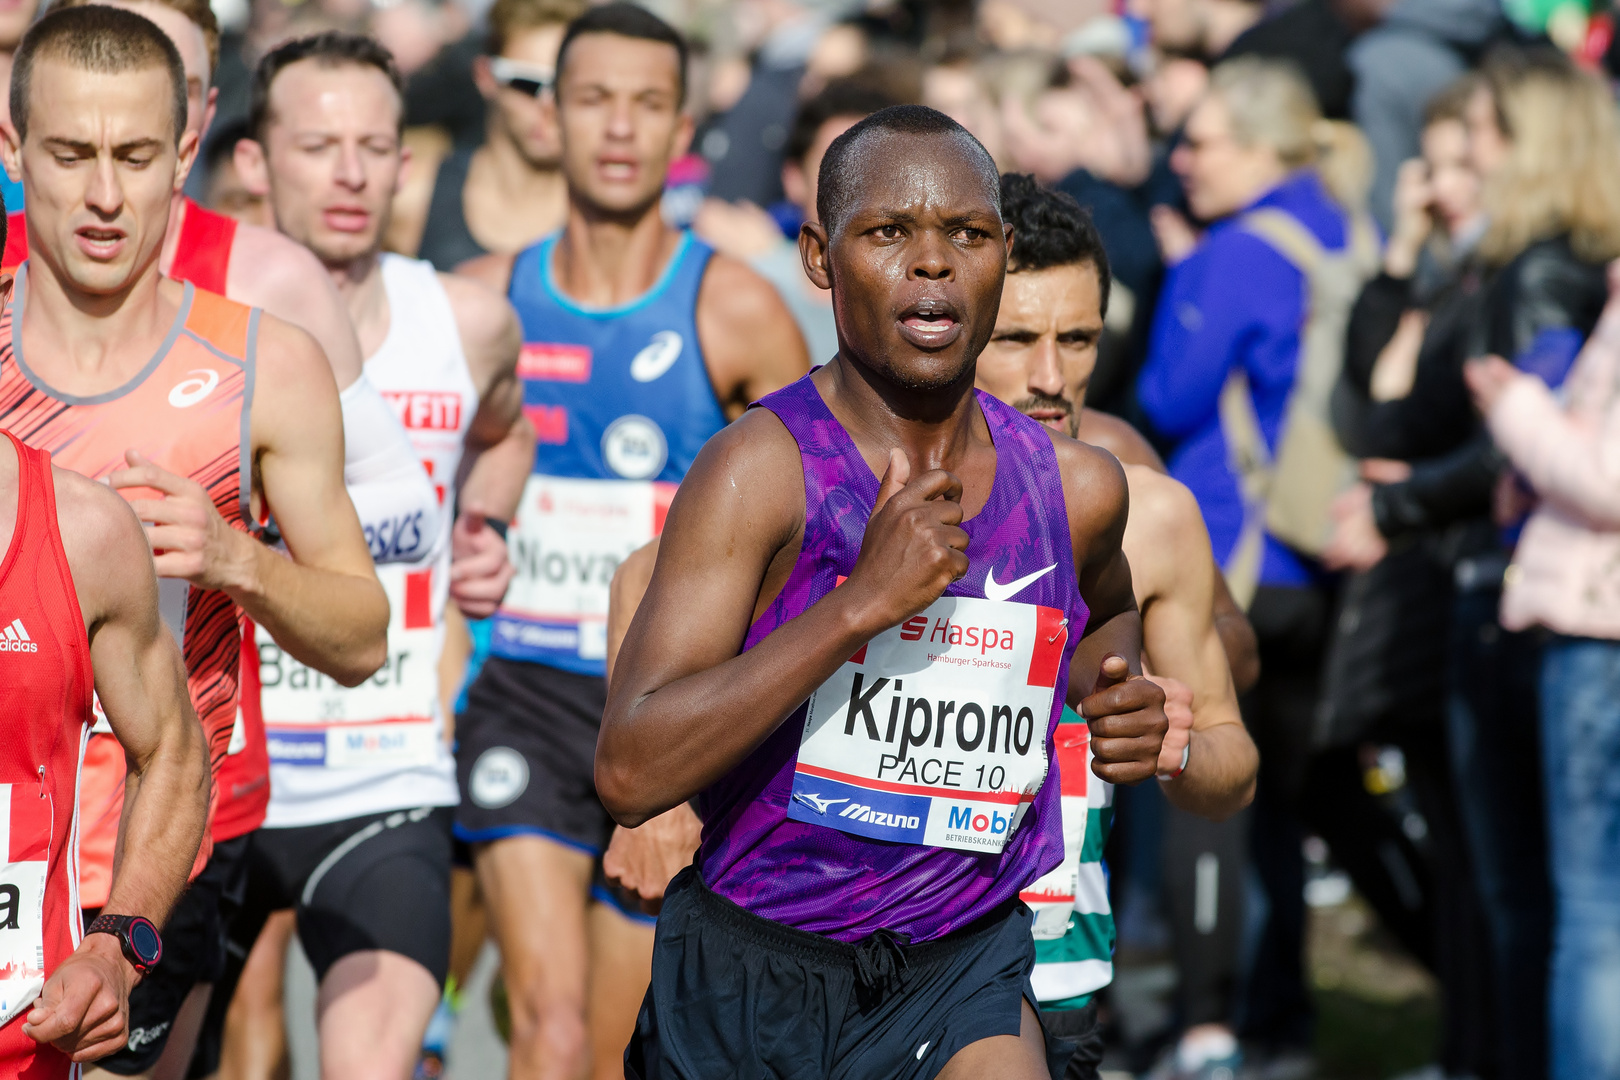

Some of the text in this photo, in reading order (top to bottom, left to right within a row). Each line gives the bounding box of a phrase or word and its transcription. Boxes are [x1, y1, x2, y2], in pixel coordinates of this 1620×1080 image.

[515, 540, 638, 585] Nova
[930, 617, 1014, 655] Haspa
[927, 653, 1012, 670] Hamburger Sparkasse
[844, 672, 1034, 762] Kiprono
[877, 754, 1006, 790] PACE 10
